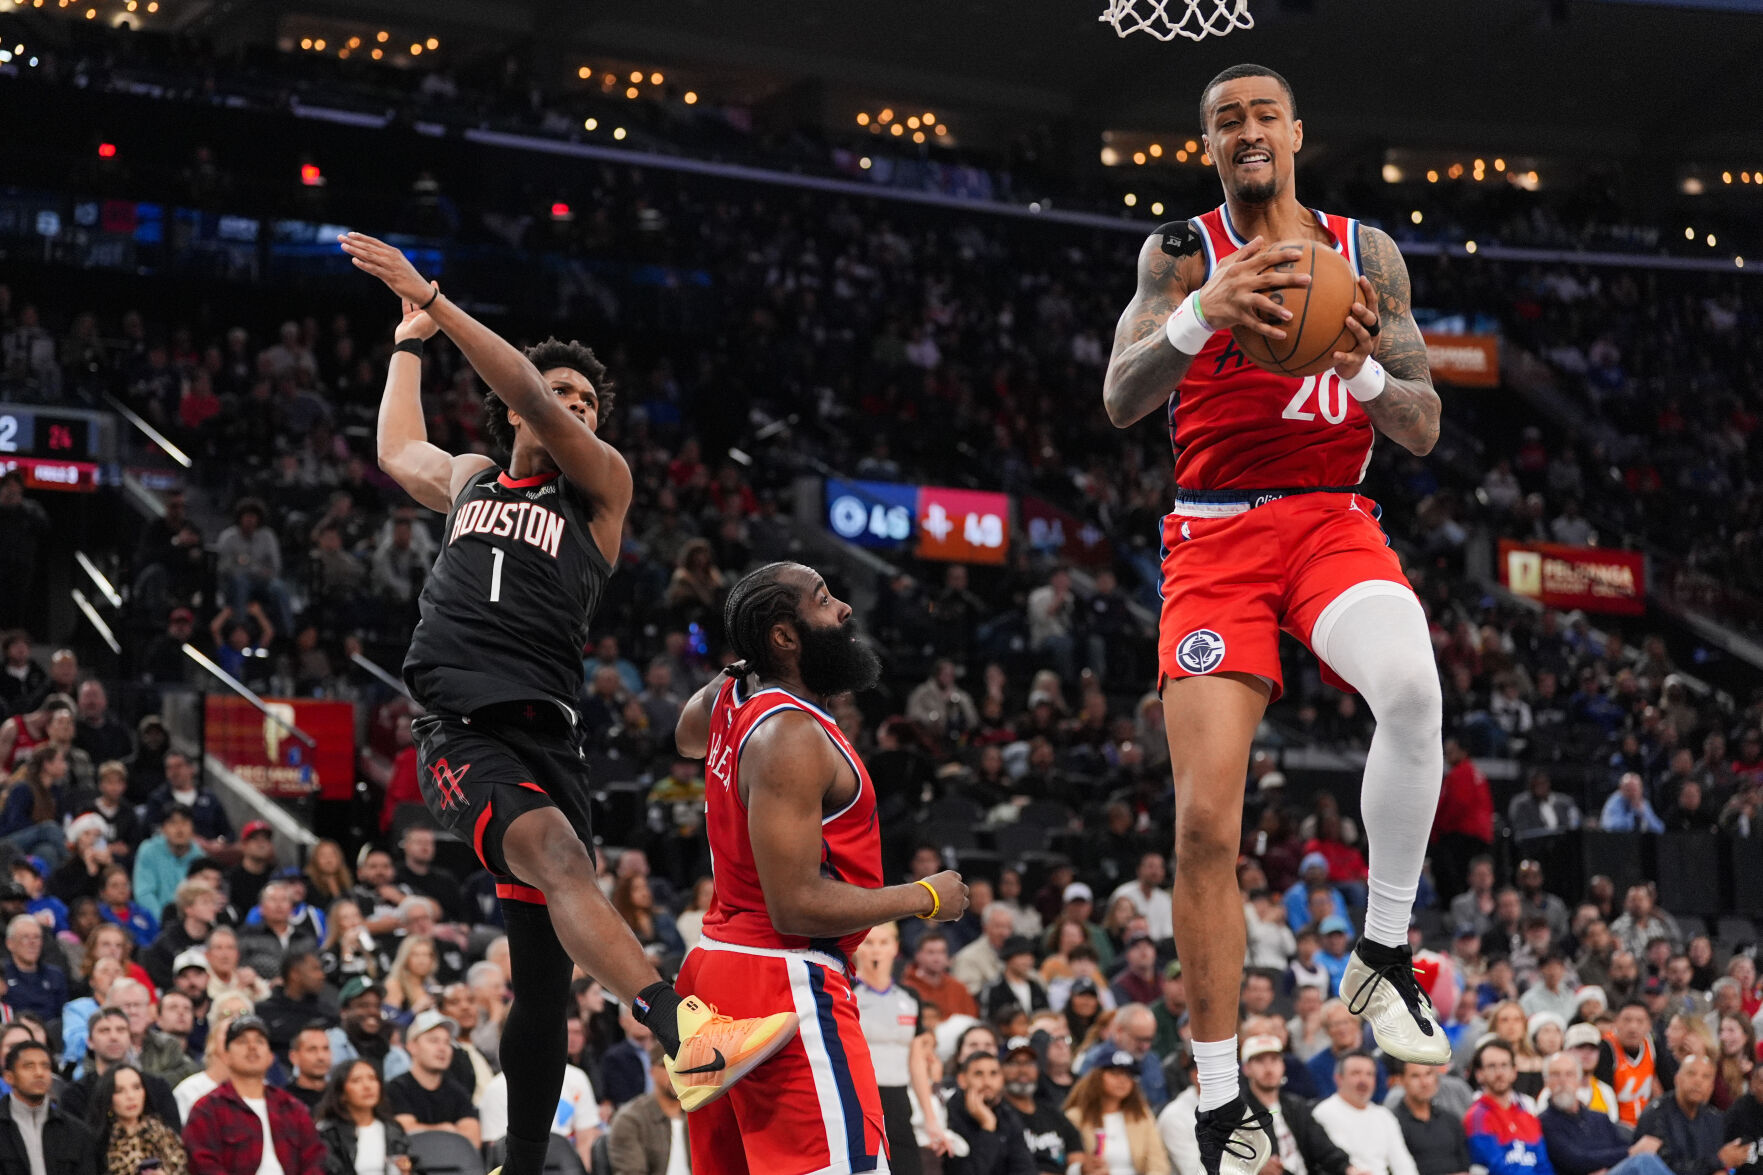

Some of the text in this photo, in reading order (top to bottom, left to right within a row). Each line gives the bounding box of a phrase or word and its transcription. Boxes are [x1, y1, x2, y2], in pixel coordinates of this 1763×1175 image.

[1281, 367, 1348, 425] 20
[448, 499, 566, 559] HOUSTON
[489, 546, 505, 602] 1
